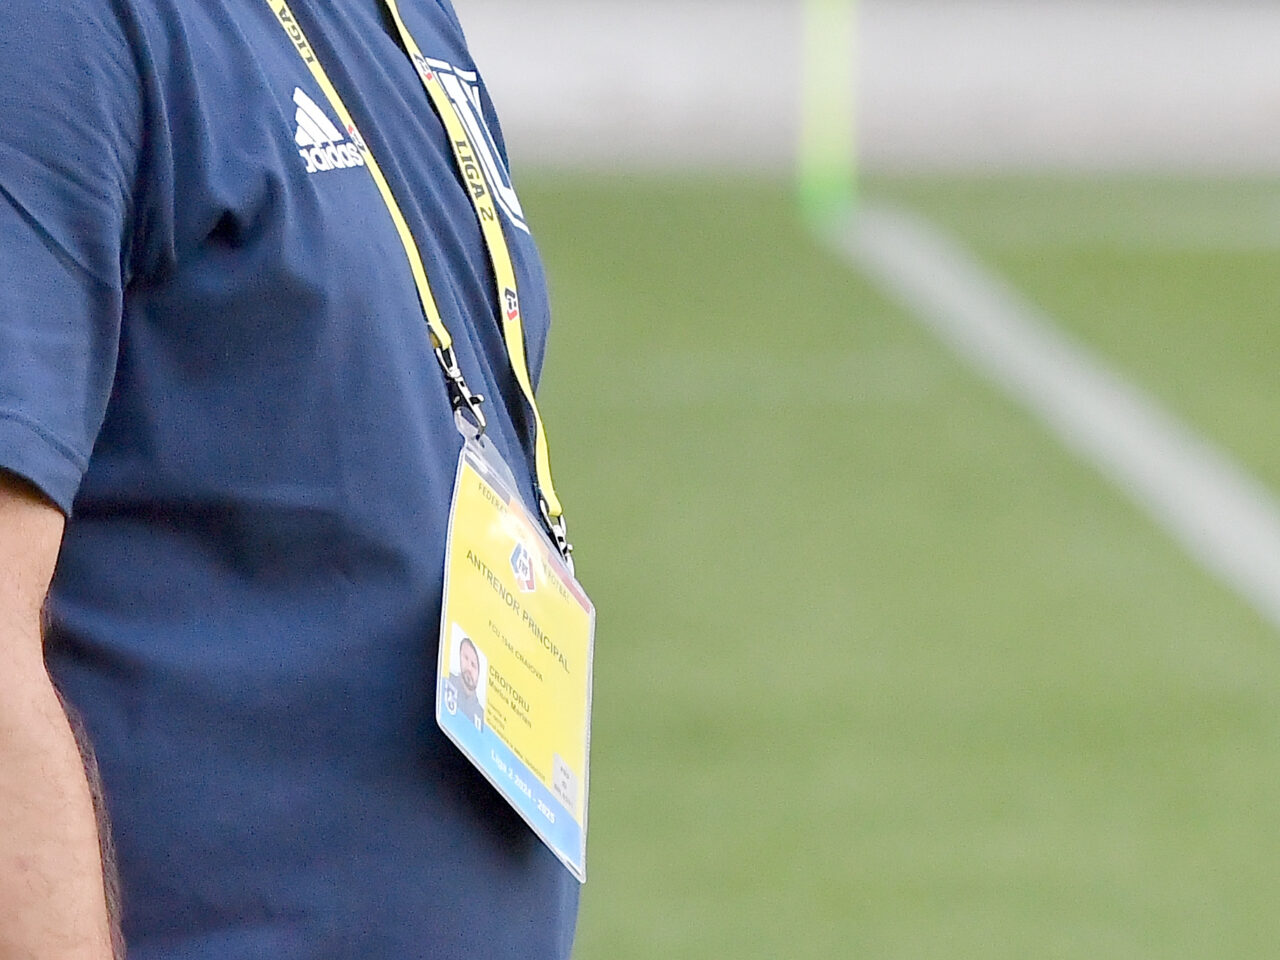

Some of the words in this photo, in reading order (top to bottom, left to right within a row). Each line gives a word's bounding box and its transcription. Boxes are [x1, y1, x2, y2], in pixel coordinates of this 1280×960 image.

[279, 5, 315, 63] LIGA
[455, 140, 486, 200] LIGA
[479, 206, 494, 221] 2
[466, 548, 519, 615] ANTRENOR
[522, 609, 569, 674] PRINCIPAL
[489, 664, 530, 713] CROITORU
